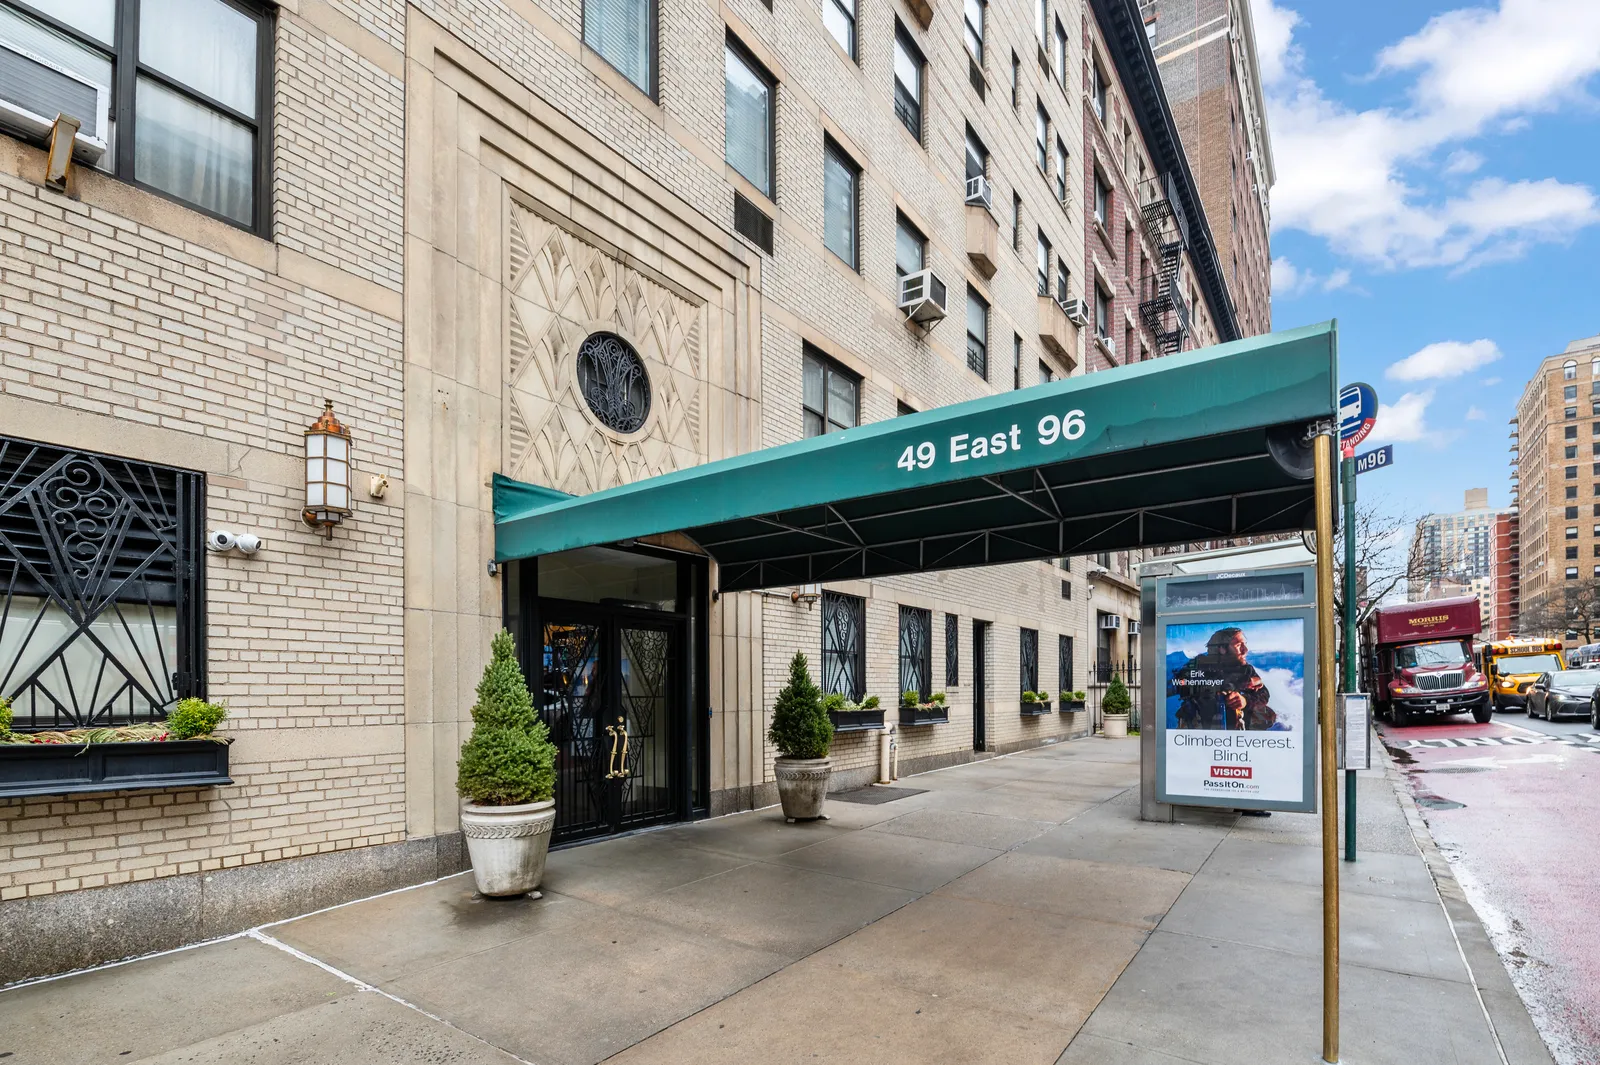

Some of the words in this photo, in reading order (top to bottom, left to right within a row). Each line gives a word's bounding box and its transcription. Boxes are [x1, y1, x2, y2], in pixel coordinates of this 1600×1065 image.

[897, 441, 936, 472] 49
[949, 423, 1021, 463] East
[1037, 409, 1086, 446] 96
[1357, 449, 1386, 472] M96
[1216, 572, 1246, 580] JCDecaux
[1408, 614, 1449, 625] MORRIS
[1510, 646, 1530, 654] SCHOOL
[1190, 670, 1205, 678] Erik
[1173, 734, 1232, 748] Climbed
[1236, 735, 1295, 749] Everest.
[1404, 736, 1544, 748] ONLY
[1213, 749, 1252, 763] Blind.
[1213, 768, 1249, 777] VISION
